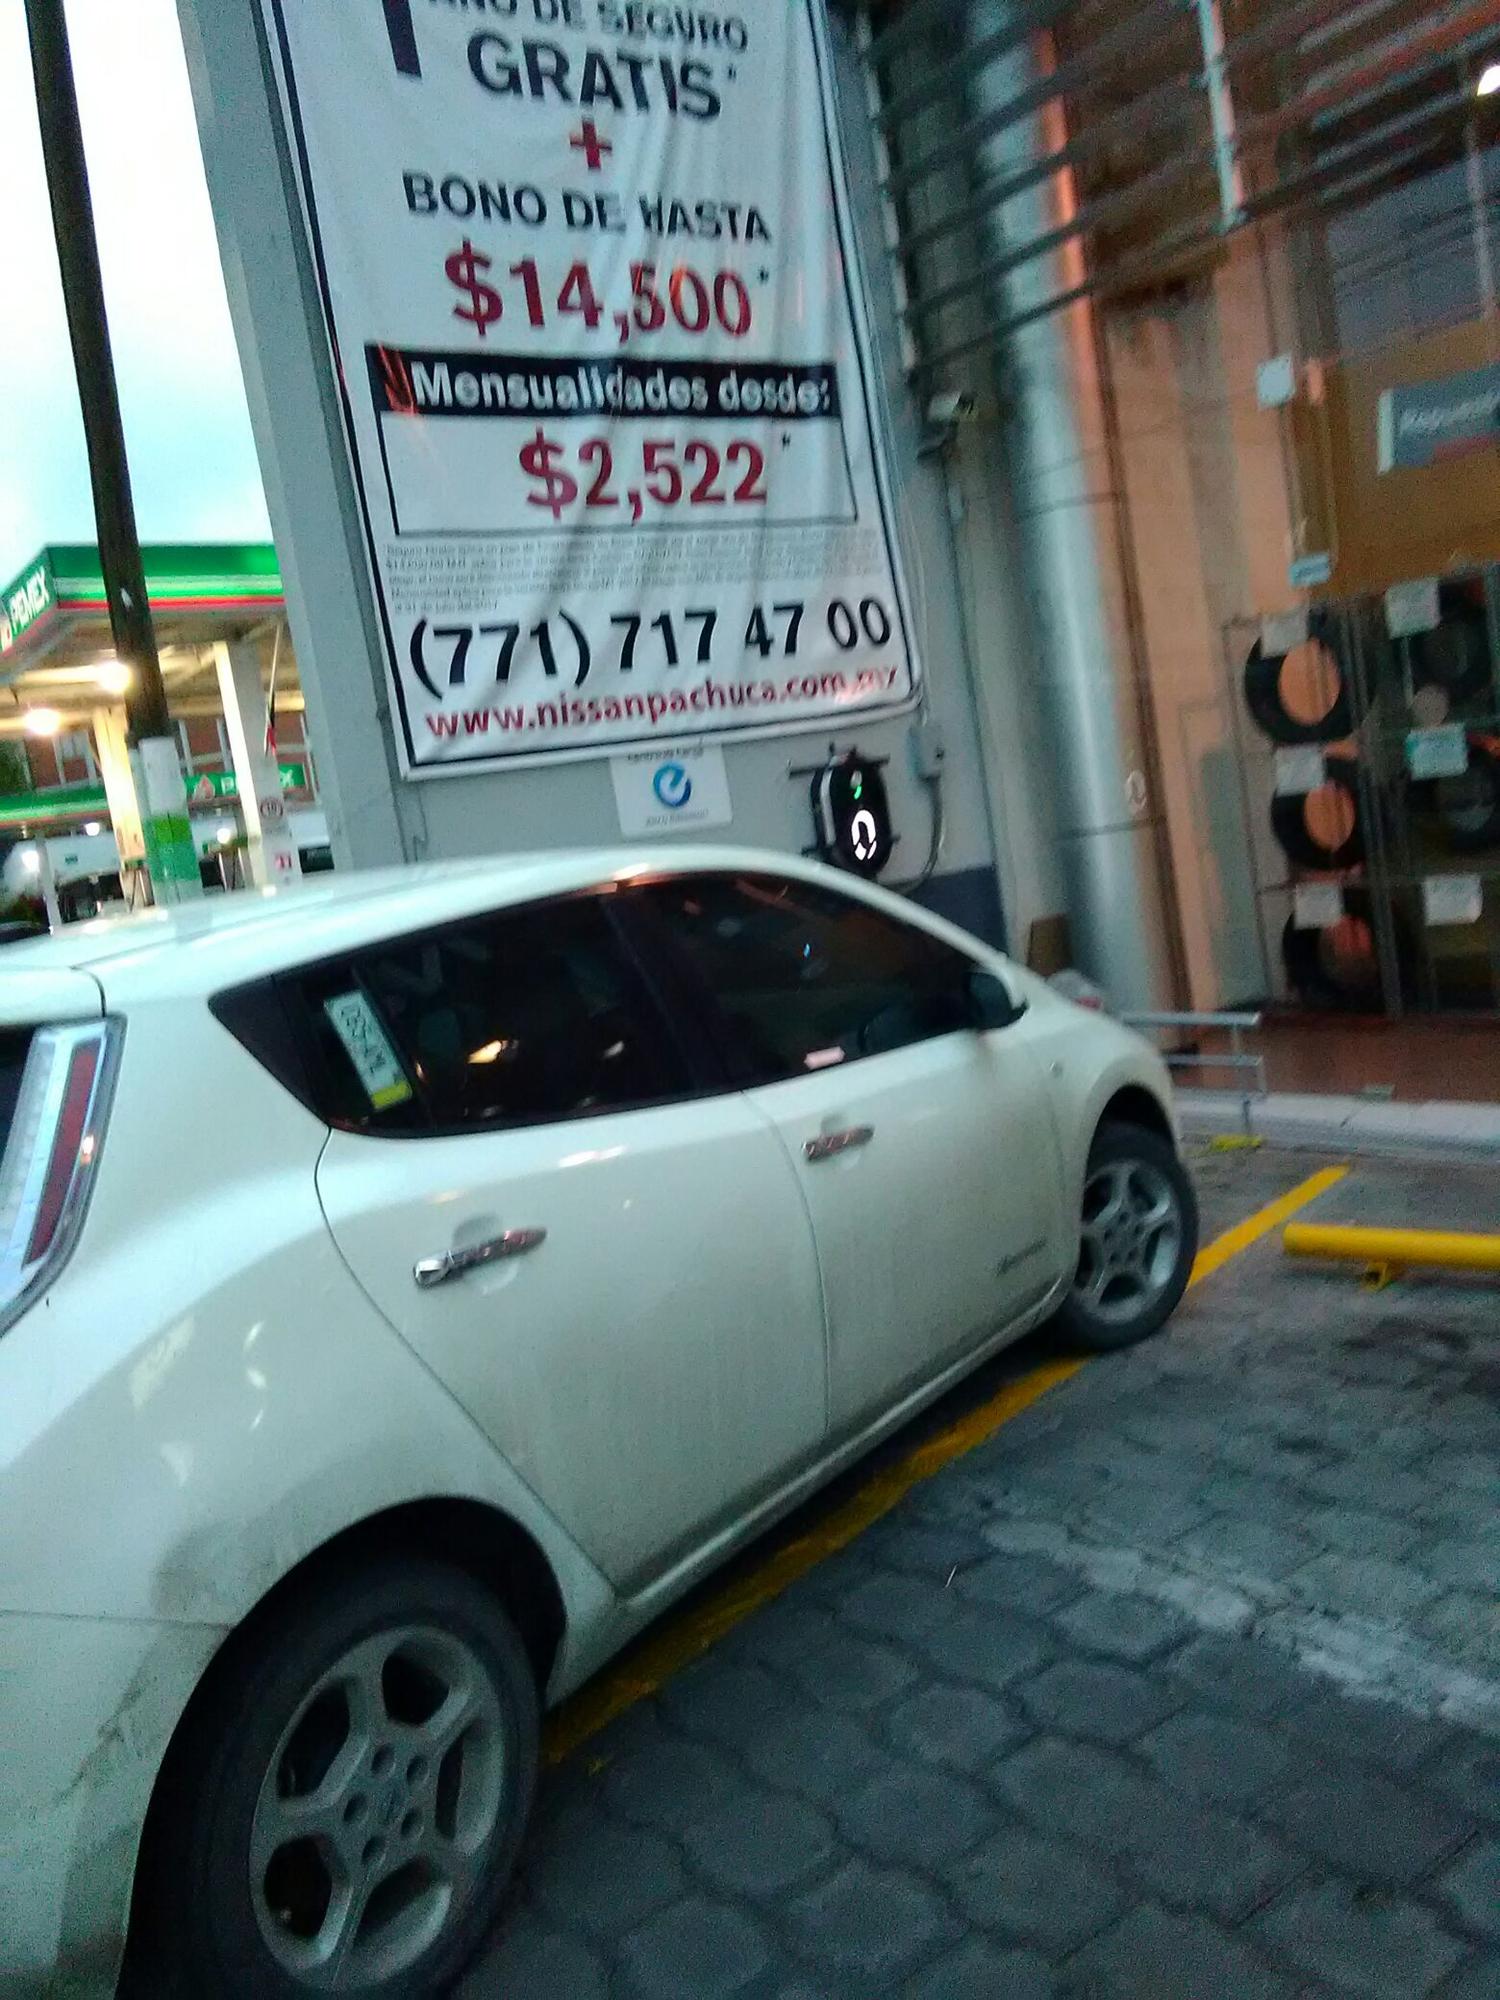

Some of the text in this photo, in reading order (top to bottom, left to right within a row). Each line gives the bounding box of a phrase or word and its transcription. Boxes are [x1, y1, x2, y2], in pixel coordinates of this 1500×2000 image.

[598, 2, 748, 52] SEGURO
[403, 170, 770, 241] BONO DE HASTA
[411, 358, 707, 411] Mensualidades
[410, 599, 891, 699] (771) 717 47 00
